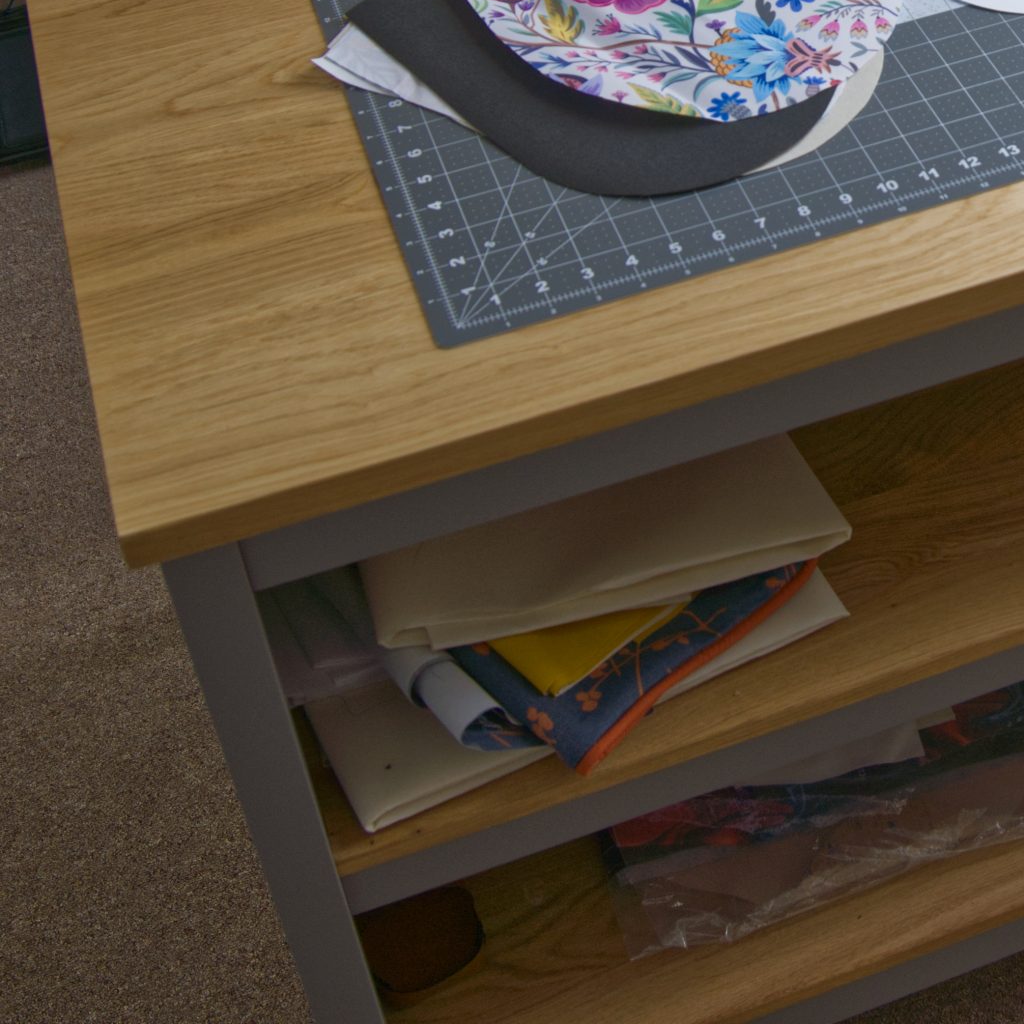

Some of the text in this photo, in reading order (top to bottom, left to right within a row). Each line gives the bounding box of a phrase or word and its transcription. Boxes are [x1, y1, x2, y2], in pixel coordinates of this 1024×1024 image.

[388, 100, 402, 108] 8
[408, 149, 422, 158] 6
[417, 175, 432, 184] 5
[428, 201, 442, 210] 4
[438, 228, 454, 238] 3
[450, 256, 466, 267] 2
[461, 286, 476, 297] 1
[490, 294, 501, 305] 1
[535, 281, 549, 293] 2
[581, 268, 594, 279] 3
[626, 255, 639, 265] 4
[669, 242, 682, 254] 5
[712, 230, 725, 241] 6
[754, 217, 766, 228] 7
[798, 205, 811, 216] 8
[839, 193, 852, 204] 9
[877, 180, 898, 192] 10
[919, 168, 939, 180] 11
[959, 156, 981, 168] 12
[999, 145, 1020, 157] 13
